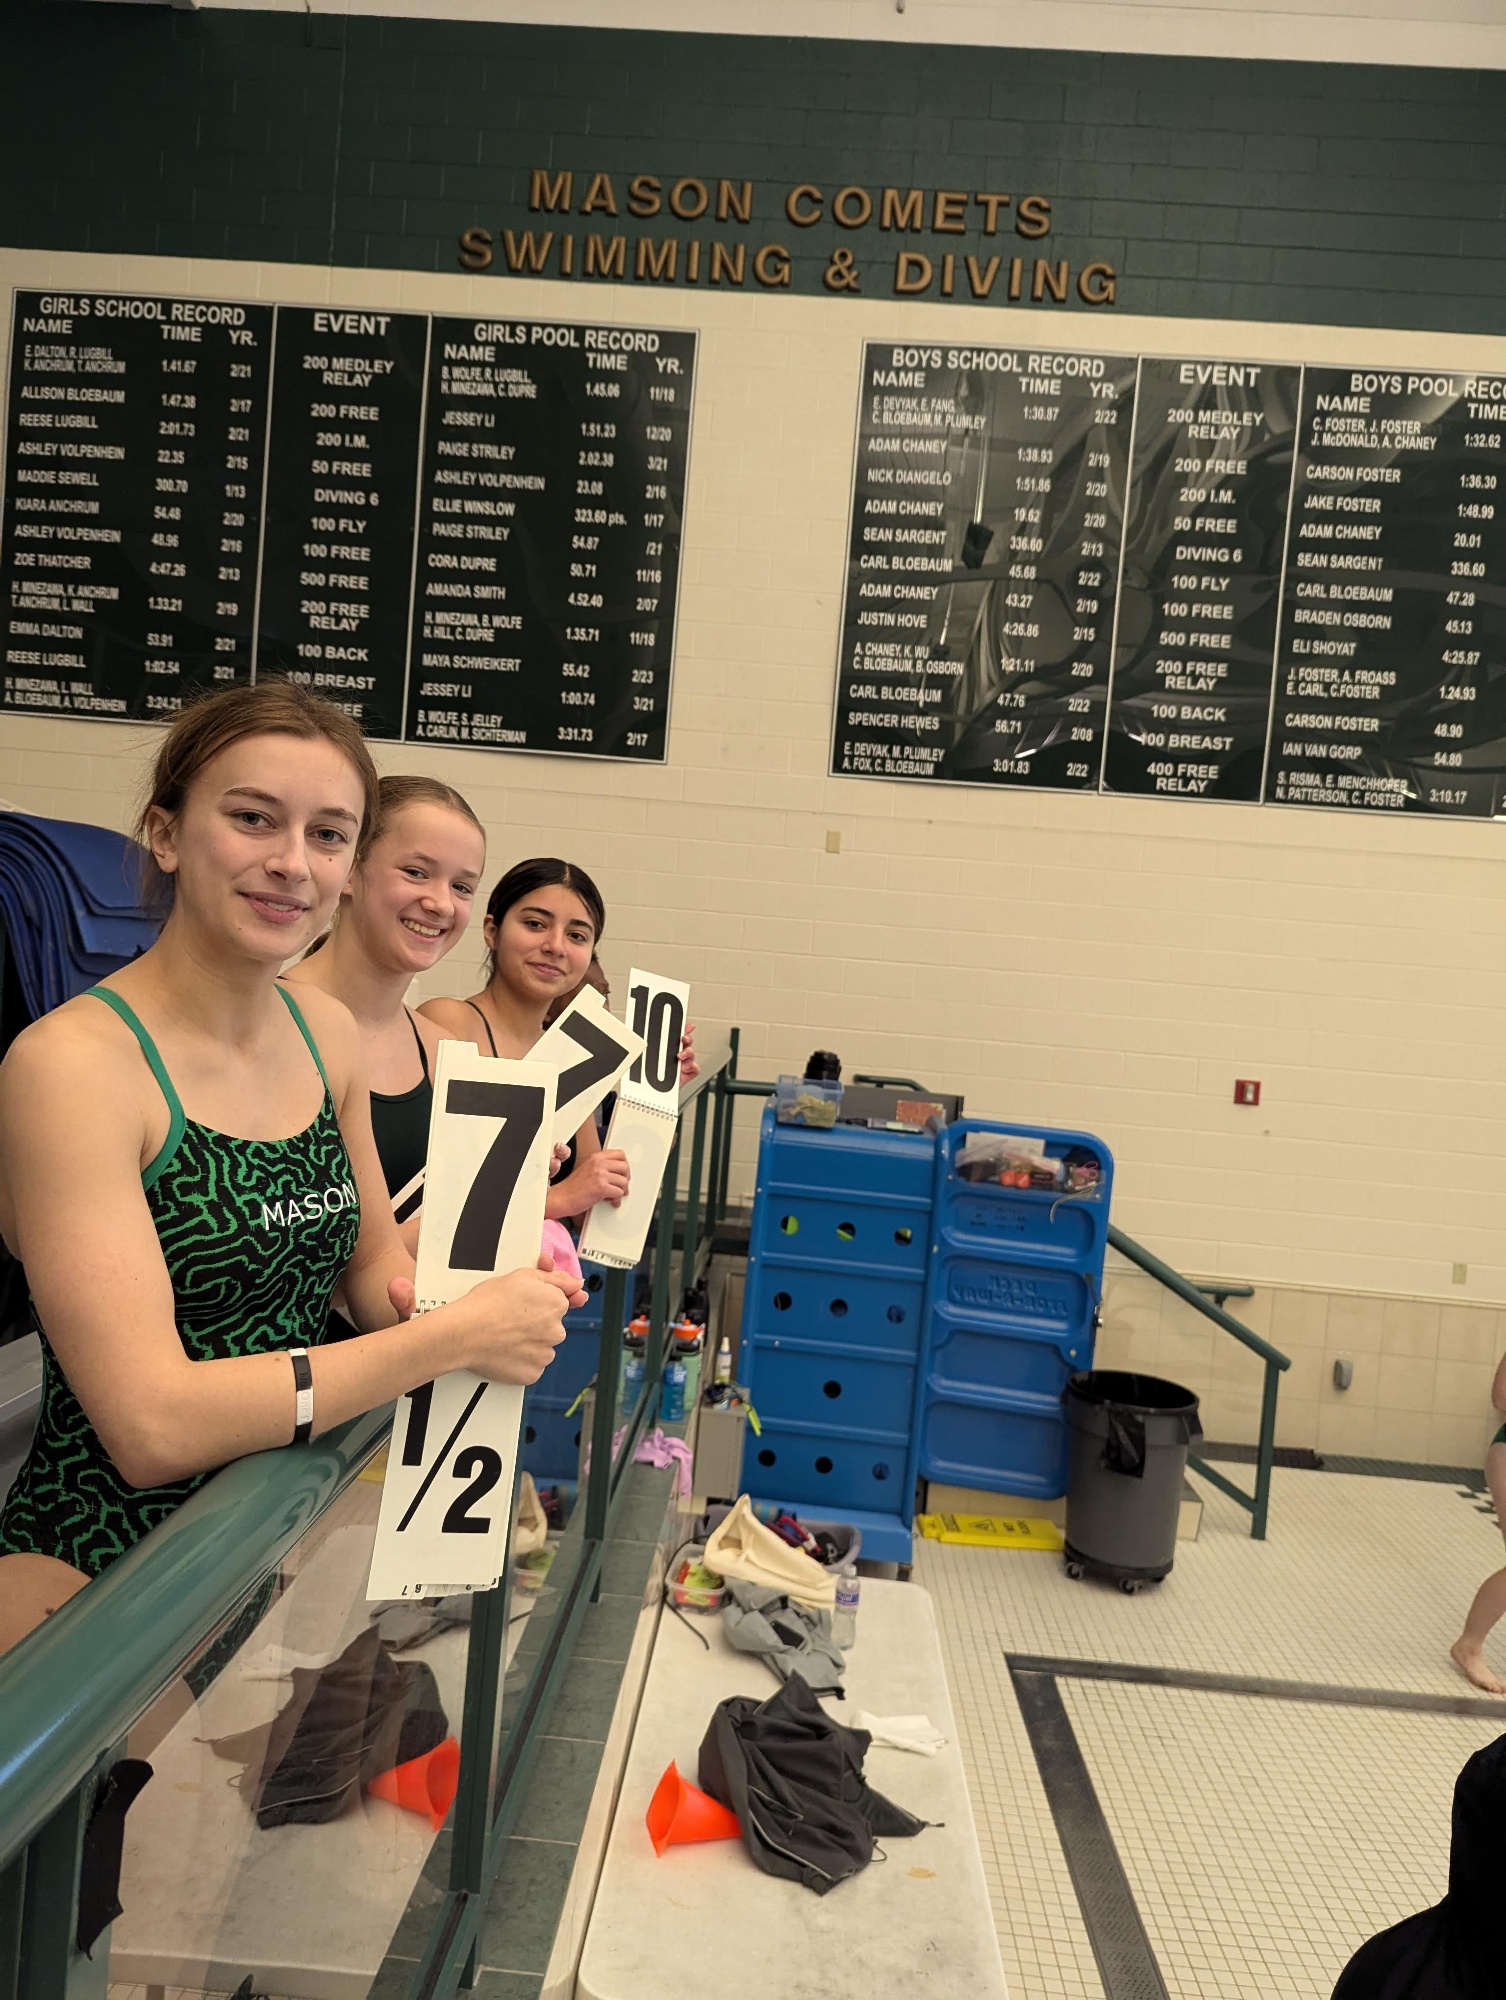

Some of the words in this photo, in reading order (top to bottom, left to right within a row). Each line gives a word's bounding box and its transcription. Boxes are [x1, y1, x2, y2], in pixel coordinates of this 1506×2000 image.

[529, 168, 754, 223] MASON
[784, 183, 1052, 239] COMETS
[459, 227, 792, 287] SWIMMING
[822, 246, 860, 291] &
[895, 251, 1118, 305] DIVING
[40, 297, 90, 316] GIRLS
[95, 299, 166, 320] SCHOOL
[171, 304, 245, 325] RECORD
[23, 319, 73, 333] NAME
[161, 325, 202, 342] TIME
[229, 330, 257, 346] YR.
[314, 312, 391, 336] EVENT
[474, 324, 526, 343] GIRLS
[531, 327, 579, 348] POOL
[584, 330, 659, 352] RECORD
[303, 356, 328, 369] 200
[332, 358, 394, 374] MEDLEY
[444, 344, 495, 361] NAME
[586, 353, 628, 370] TIME
[656, 358, 684, 375] YR.
[892, 349, 942, 368] BOYS
[947, 352, 1022, 372] SCHOOL
[1028, 355, 1104, 378] RECORD
[323, 372, 372, 387] RELAY
[1180, 364, 1261, 387] EVENT
[873, 371, 925, 388] NAME
[1019, 377, 1061, 395] TIME
[1090, 382, 1119, 399] YR.
[1351, 374, 1401, 394] BOYS
[1407, 377, 1459, 397] POOL
[21, 386, 65, 400] ALLISON
[67, 389, 125, 403] BLOEBAUM
[311, 404, 336, 418] 200
[339, 405, 379, 420] FREE
[1316, 395, 1371, 412] NAME
[19, 414, 53, 427] REESE
[55, 415, 98, 428] LUGBILL
[442, 411, 483, 426] JESSEY
[485, 414, 495, 427] LI
[1095, 410, 1117, 425] 2/22
[1167, 409, 1193, 423] 200
[1198, 410, 1264, 426] MEDLEY
[316, 432, 341, 446] 200
[345, 434, 369, 448] I.M.
[1188, 425, 1240, 440] RELAY
[868, 438, 900, 451] ADAM
[902, 440, 947, 454] CHANEY
[312, 460, 329, 474] 50
[332, 461, 372, 477] FREE
[1175, 458, 1200, 472] 200
[1205, 460, 1247, 475] FREE
[1306, 465, 1354, 480] CARSON
[1356, 467, 1400, 483] FOSTER
[868, 470, 894, 483] NICK
[897, 471, 951, 485] DIANGELO
[314, 488, 365, 505] DIVING
[369, 493, 379, 506] 6
[1180, 488, 1205, 502] 200
[1210, 489, 1236, 504] I.M.
[1304, 495, 1334, 509] JAKE
[1336, 497, 1381, 513] FOSTER
[16, 498, 48, 512] KIARA
[865, 500, 897, 514] ADAM
[899, 501, 943, 516] CHANEY
[311, 517, 336, 531] 100
[339, 519, 367, 533] FLY
[1174, 517, 1191, 531] 50
[1196, 518, 1238, 533] FREE
[1299, 523, 1333, 538] ADAM
[1335, 525, 1382, 540] CHANEY
[864, 528, 892, 542] SEAN
[896, 529, 947, 544] SARGENT
[1453, 533, 1481, 548] 20.01
[14, 553, 35, 566] ZOE
[38, 554, 91, 569] THATCHER
[303, 544, 327, 557] 100
[331, 546, 370, 561] FREE
[1176, 546, 1229, 561] DIVING
[1233, 549, 1242, 563] 6
[428, 554, 458, 569] CORA
[461, 556, 497, 572] DUPRE
[861, 556, 889, 569] CARL
[892, 557, 953, 572] BLOEBAUM
[1297, 553, 1328, 568] SEAN
[1330, 555, 1383, 570] SARGENT
[300, 572, 325, 586] 500
[329, 574, 369, 590] FREE
[1171, 575, 1197, 590] 100
[1200, 577, 1230, 591] FLY
[426, 583, 472, 597] AMANDA
[474, 586, 506, 599] SMITH
[859, 584, 891, 597] ADAM
[894, 585, 938, 600] CHANEY
[1296, 584, 1326, 598] CARL
[1330, 585, 1393, 601] BLOEBAUM
[301, 601, 326, 614] 200
[330, 603, 369, 619] FREE
[1162, 602, 1188, 616] 100
[1192, 604, 1234, 619] FREE
[310, 616, 360, 631] RELAY
[857, 612, 895, 625] JUSTIN
[897, 614, 927, 628] HOVE
[1294, 609, 1341, 625] BRADEN
[1343, 612, 1392, 629] OSBORN
[1160, 632, 1185, 646] 500
[1190, 633, 1231, 648] FREE
[1292, 639, 1310, 652] ELI
[1312, 641, 1357, 656] SHOYAT
[297, 644, 322, 657] 100
[325, 646, 369, 661] BACK
[422, 654, 450, 667] MAYA
[632, 670, 653, 684] 2/23
[1155, 660, 1182, 674] 200
[1186, 661, 1228, 677] FREE
[315, 673, 375, 689] BREAST
[1165, 675, 1217, 691] RELAY
[850, 685, 879, 699] CARL
[881, 686, 942, 702] BLOEBAUM
[848, 712, 898, 727] SPENCER
[901, 715, 940, 730] HEWES
[1151, 705, 1177, 718] 100
[1181, 706, 1226, 722] BACK
[1285, 714, 1332, 728] CARSON
[1335, 716, 1380, 732] FOSTER
[1141, 733, 1165, 746] 100
[1169, 734, 1234, 750] BREAST
[1283, 742, 1302, 755] IAN
[1305, 744, 1328, 757] VAN
[1329, 745, 1362, 759] GORP
[1147, 762, 1173, 776] 400
[1177, 764, 1219, 779] FREE
[1156, 778, 1208, 793] RELAY
[629, 985, 684, 1093] 10
[558, 1010, 630, 1112] 7
[446, 1079, 545, 1271] 7
[262, 1179, 358, 1231] MASON
[396, 1380, 503, 1534] 1/2
